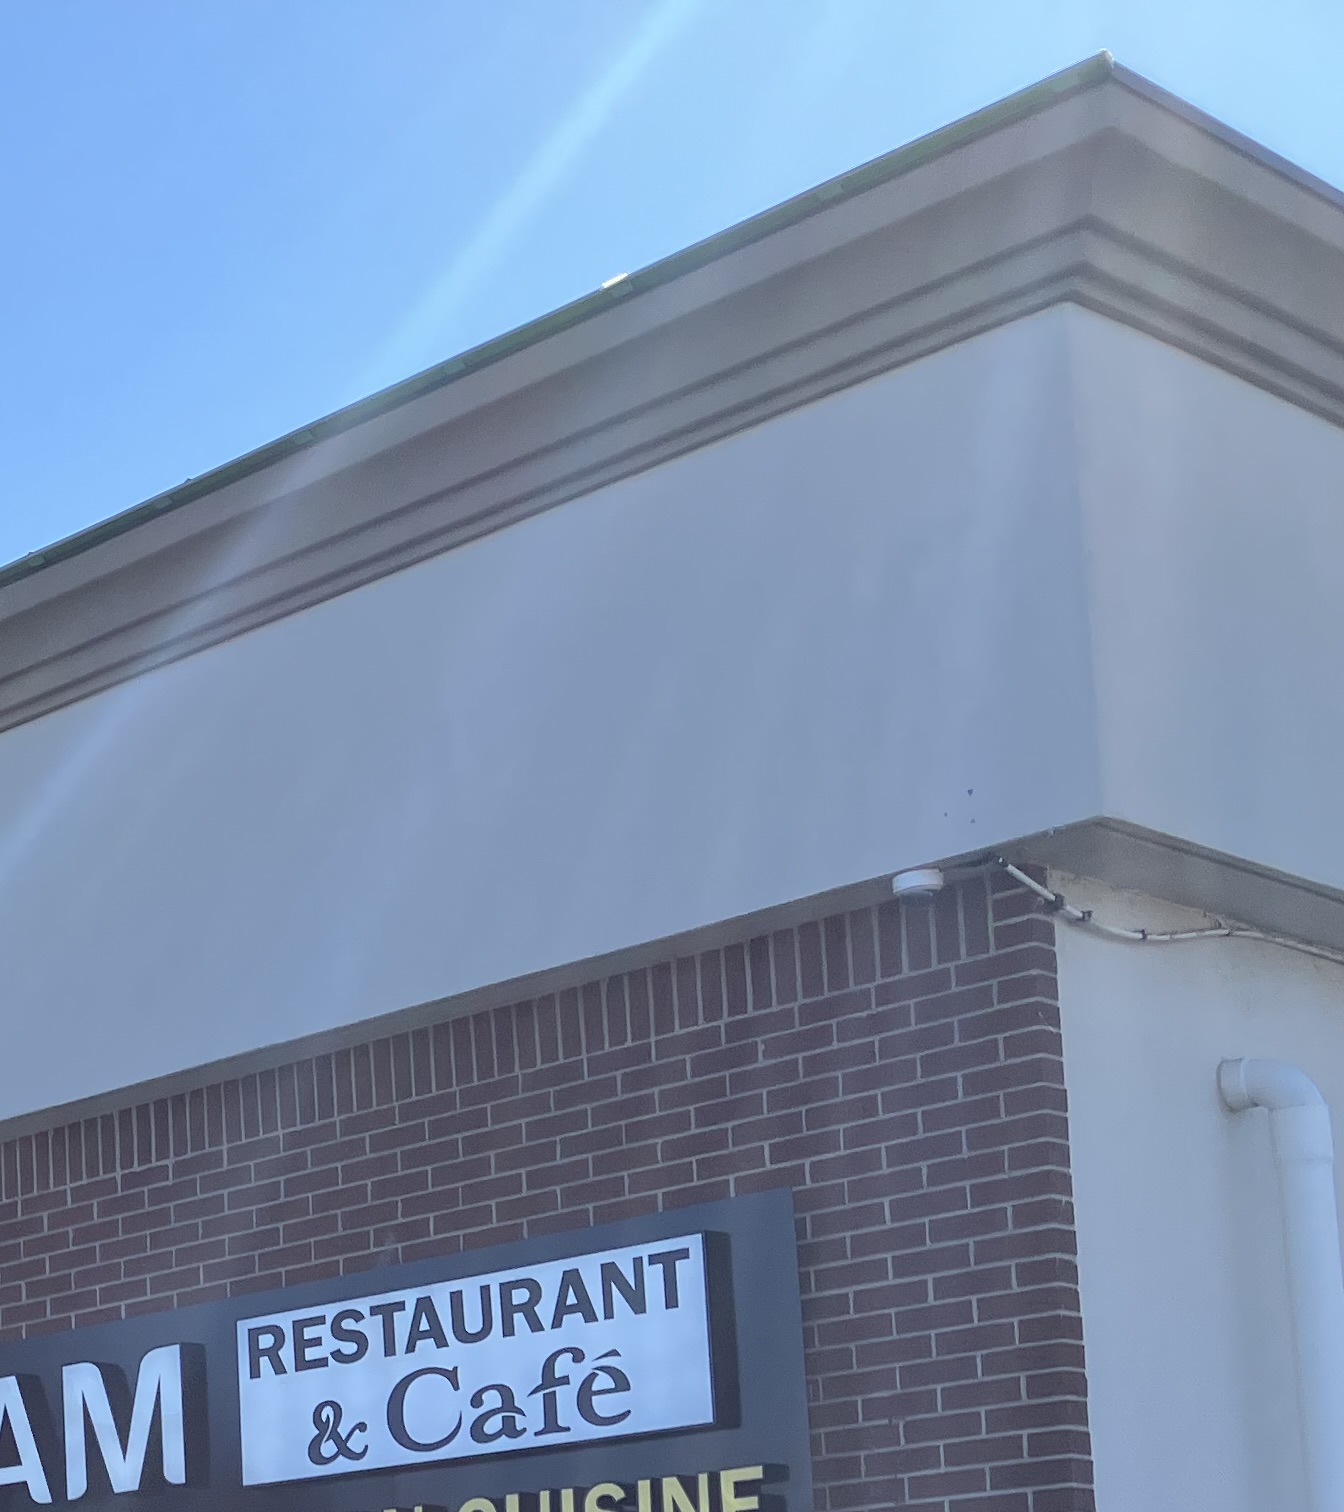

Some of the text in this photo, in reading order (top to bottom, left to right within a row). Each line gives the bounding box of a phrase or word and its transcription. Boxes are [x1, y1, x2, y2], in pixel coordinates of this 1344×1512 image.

[248, 1248, 690, 1379] RESTAURANT
[307, 1346, 632, 1465] & Café
